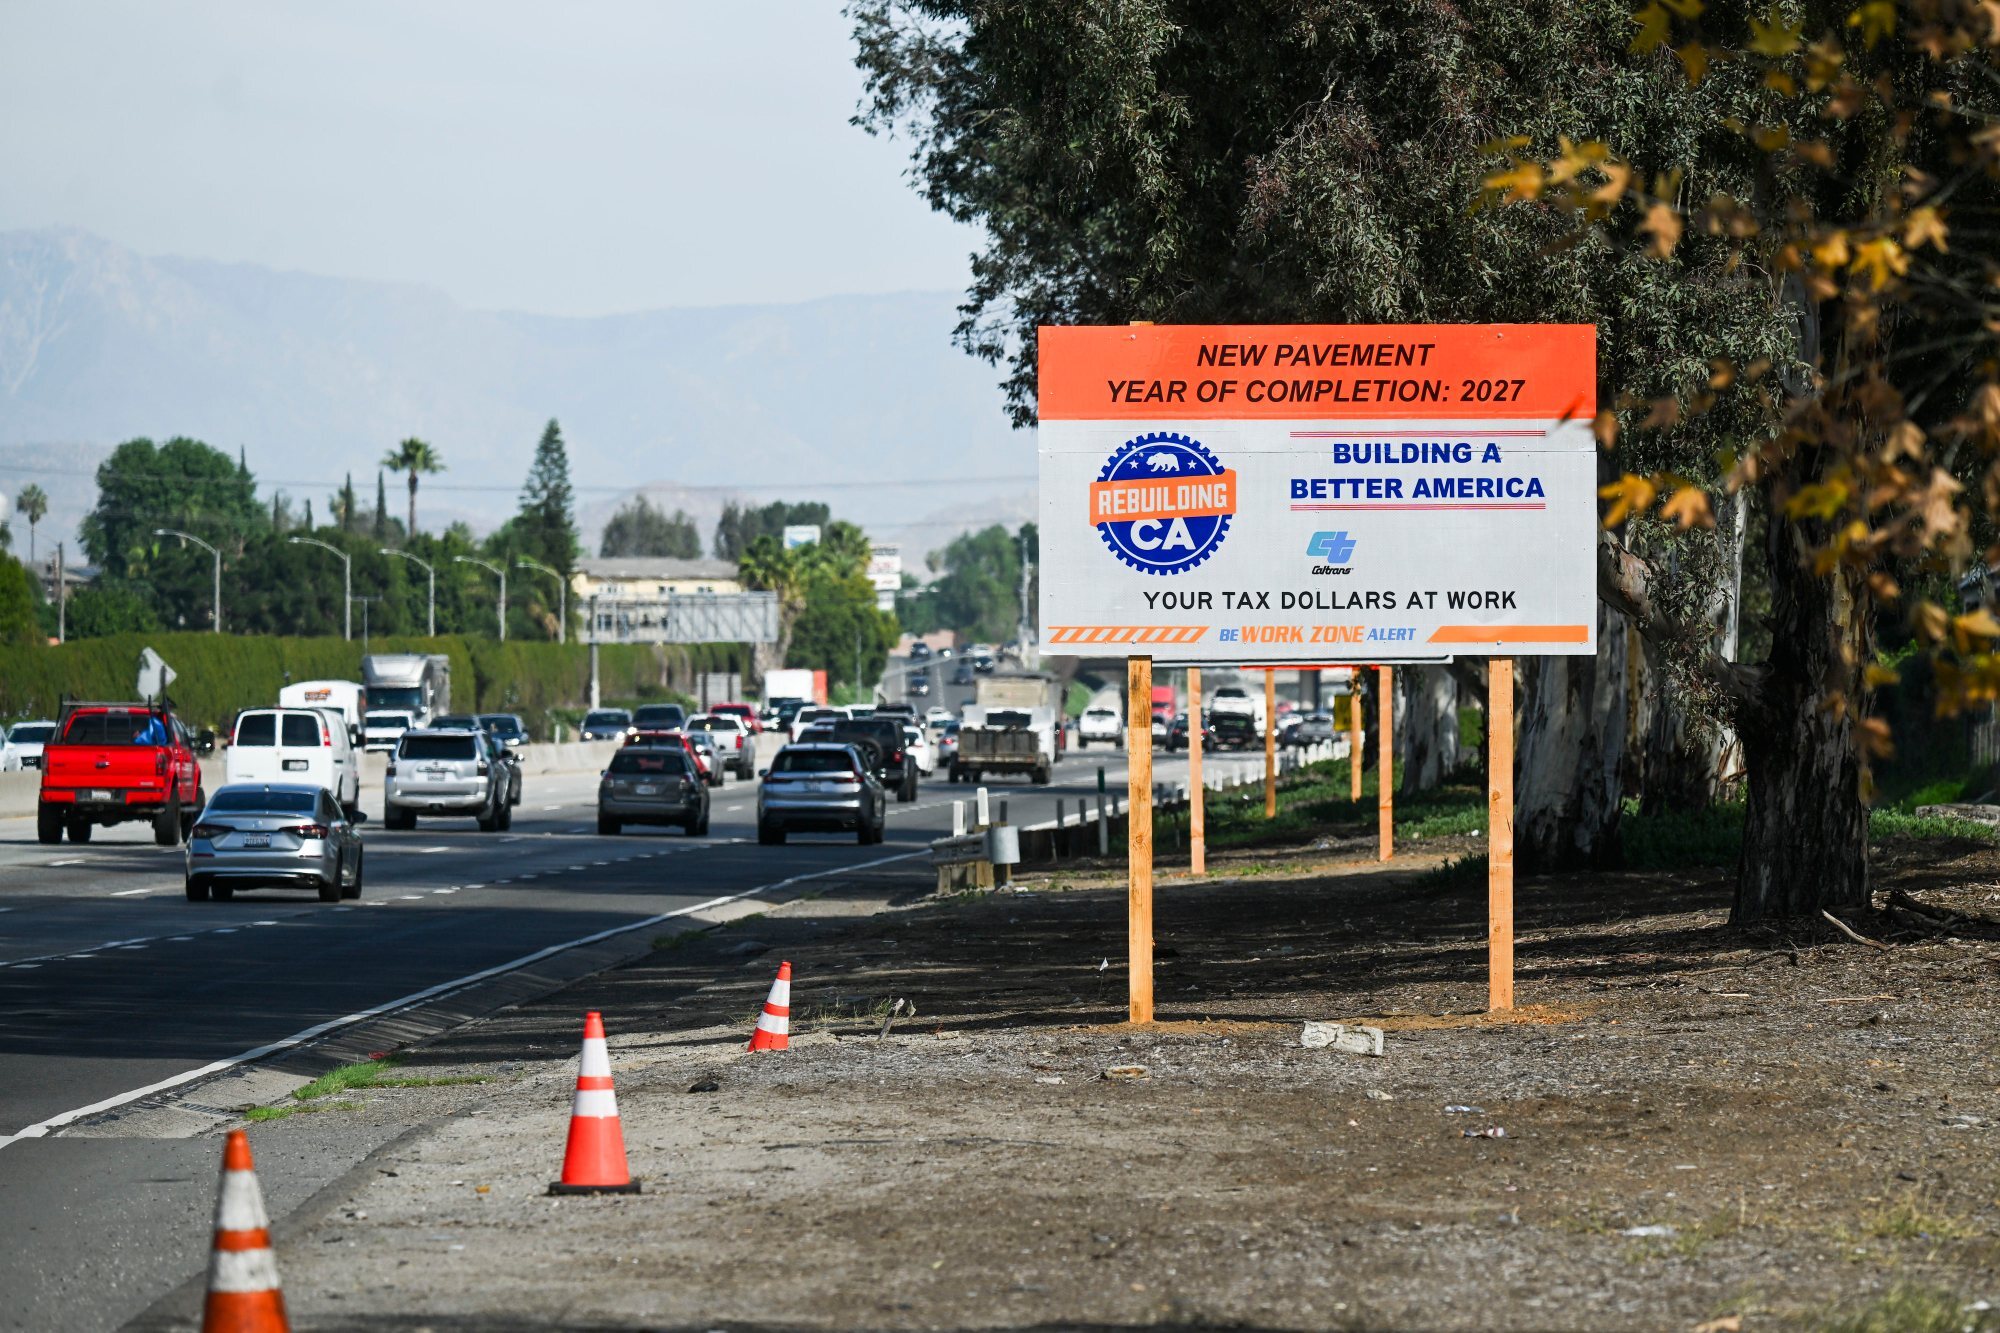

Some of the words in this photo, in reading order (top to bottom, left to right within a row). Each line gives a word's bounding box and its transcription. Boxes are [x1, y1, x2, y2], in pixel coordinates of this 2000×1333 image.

[1197, 344, 1267, 367] NEW
[1274, 343, 1436, 367] PAVEMENT
[1107, 380, 1187, 403] YEAR
[1196, 380, 1238, 403] OF
[1247, 379, 1450, 403] COMPLETION:
[1460, 379, 1526, 402] 2027
[1333, 442, 1472, 464] BUILDING
[1481, 442, 1502, 463] A
[1098, 483, 1228, 515] REBUILDING
[1290, 478, 1404, 499] BETTER
[1411, 477, 1546, 498] AMERICA
[1130, 518, 1196, 550] CA
[1311, 565, 1354, 575] Caltrans
[1142, 591, 1213, 610] YOUR
[1221, 591, 1271, 610] TAX
[1281, 590, 1397, 610] DOLLARS
[1406, 591, 1438, 610] AT
[1446, 590, 1517, 610] WORK
[1219, 627, 1239, 643] BE
[1241, 626, 1304, 643] WORK
[1310, 626, 1365, 643] ZONE
[1366, 626, 1417, 643] ALERT
